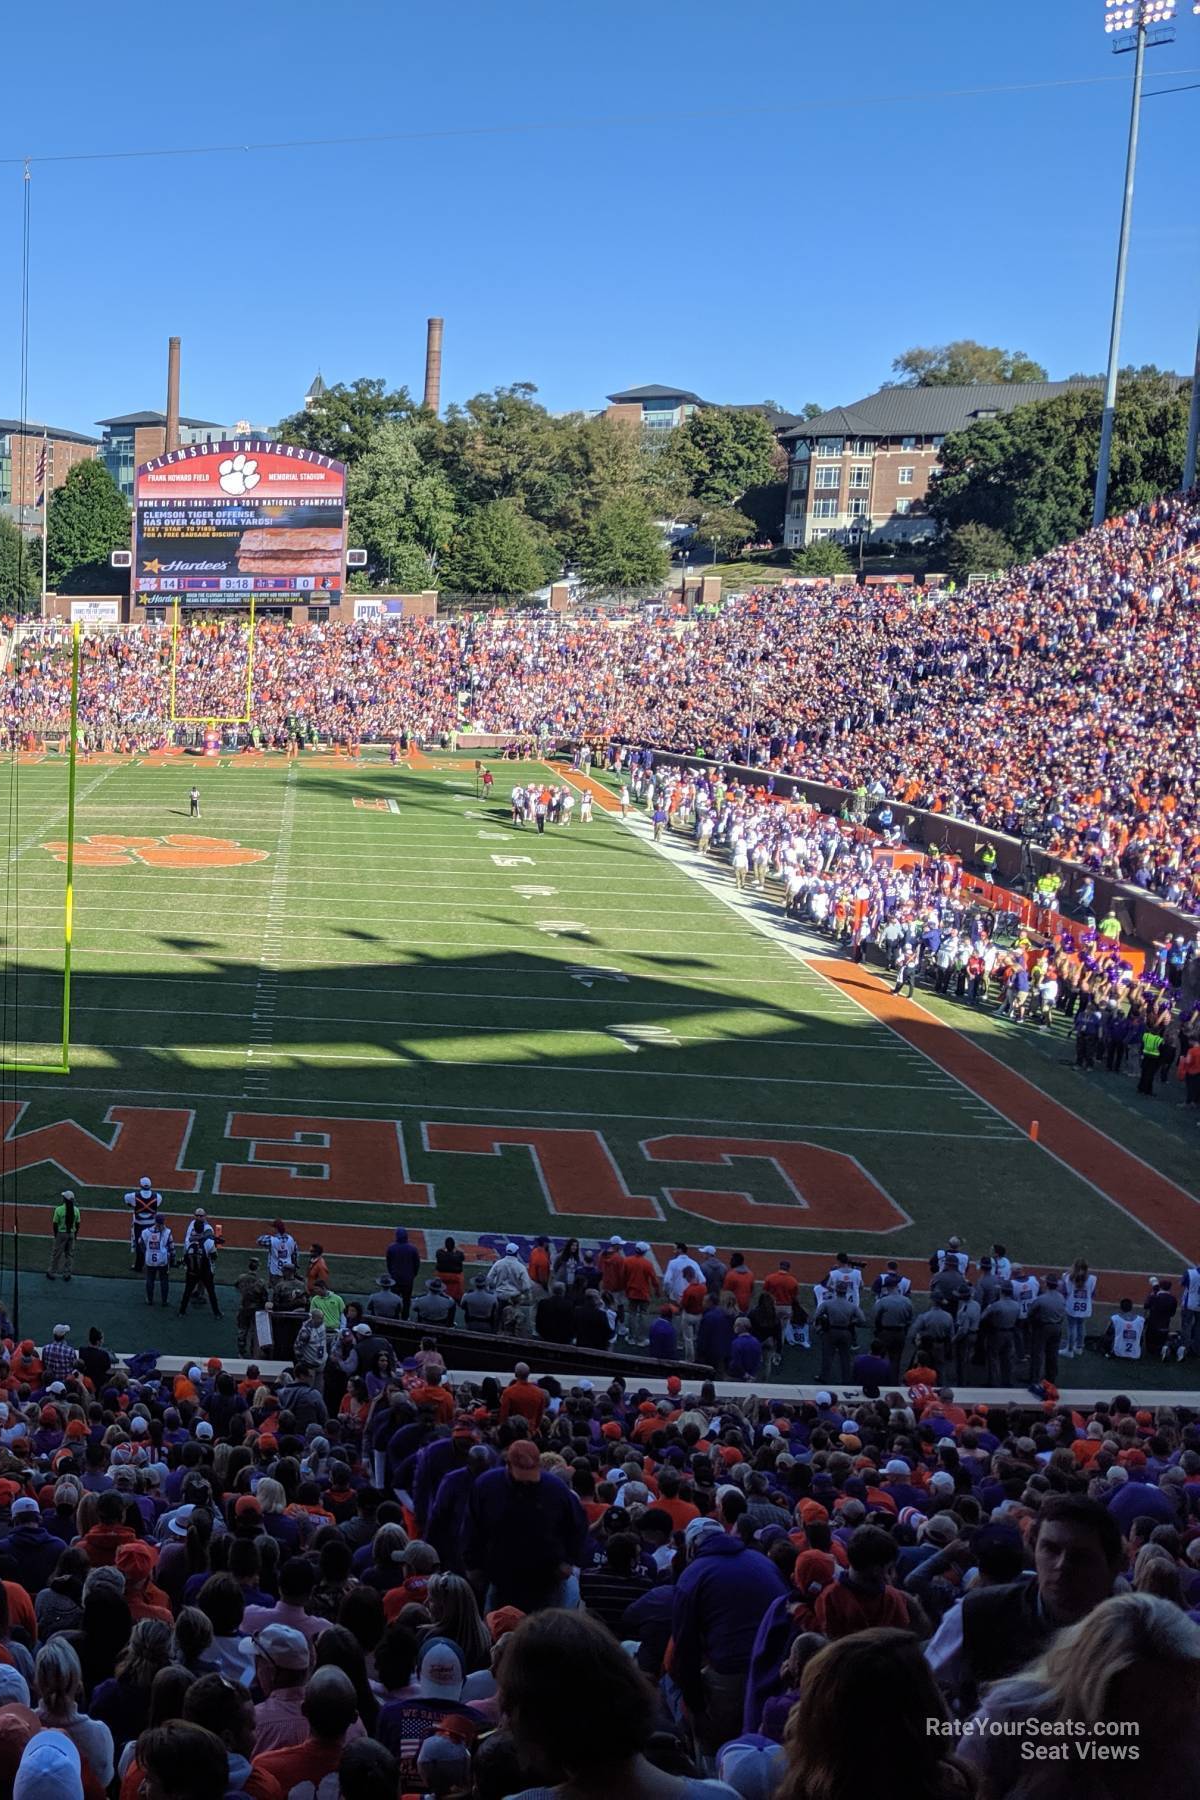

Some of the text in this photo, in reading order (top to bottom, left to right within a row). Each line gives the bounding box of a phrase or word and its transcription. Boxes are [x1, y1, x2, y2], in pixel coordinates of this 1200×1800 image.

[146, 441, 334, 471] CLEMSON UNIVERSITY
[161, 560, 227, 572] Hardee's
[164, 580, 175, 588] 14
[226, 580, 248, 589] 9:18
[303, 580, 308, 588] 0
[358, 606, 381, 618] IPTAY
[152, 1253, 157, 1262] 6
[1126, 1343, 1132, 1352] 2
